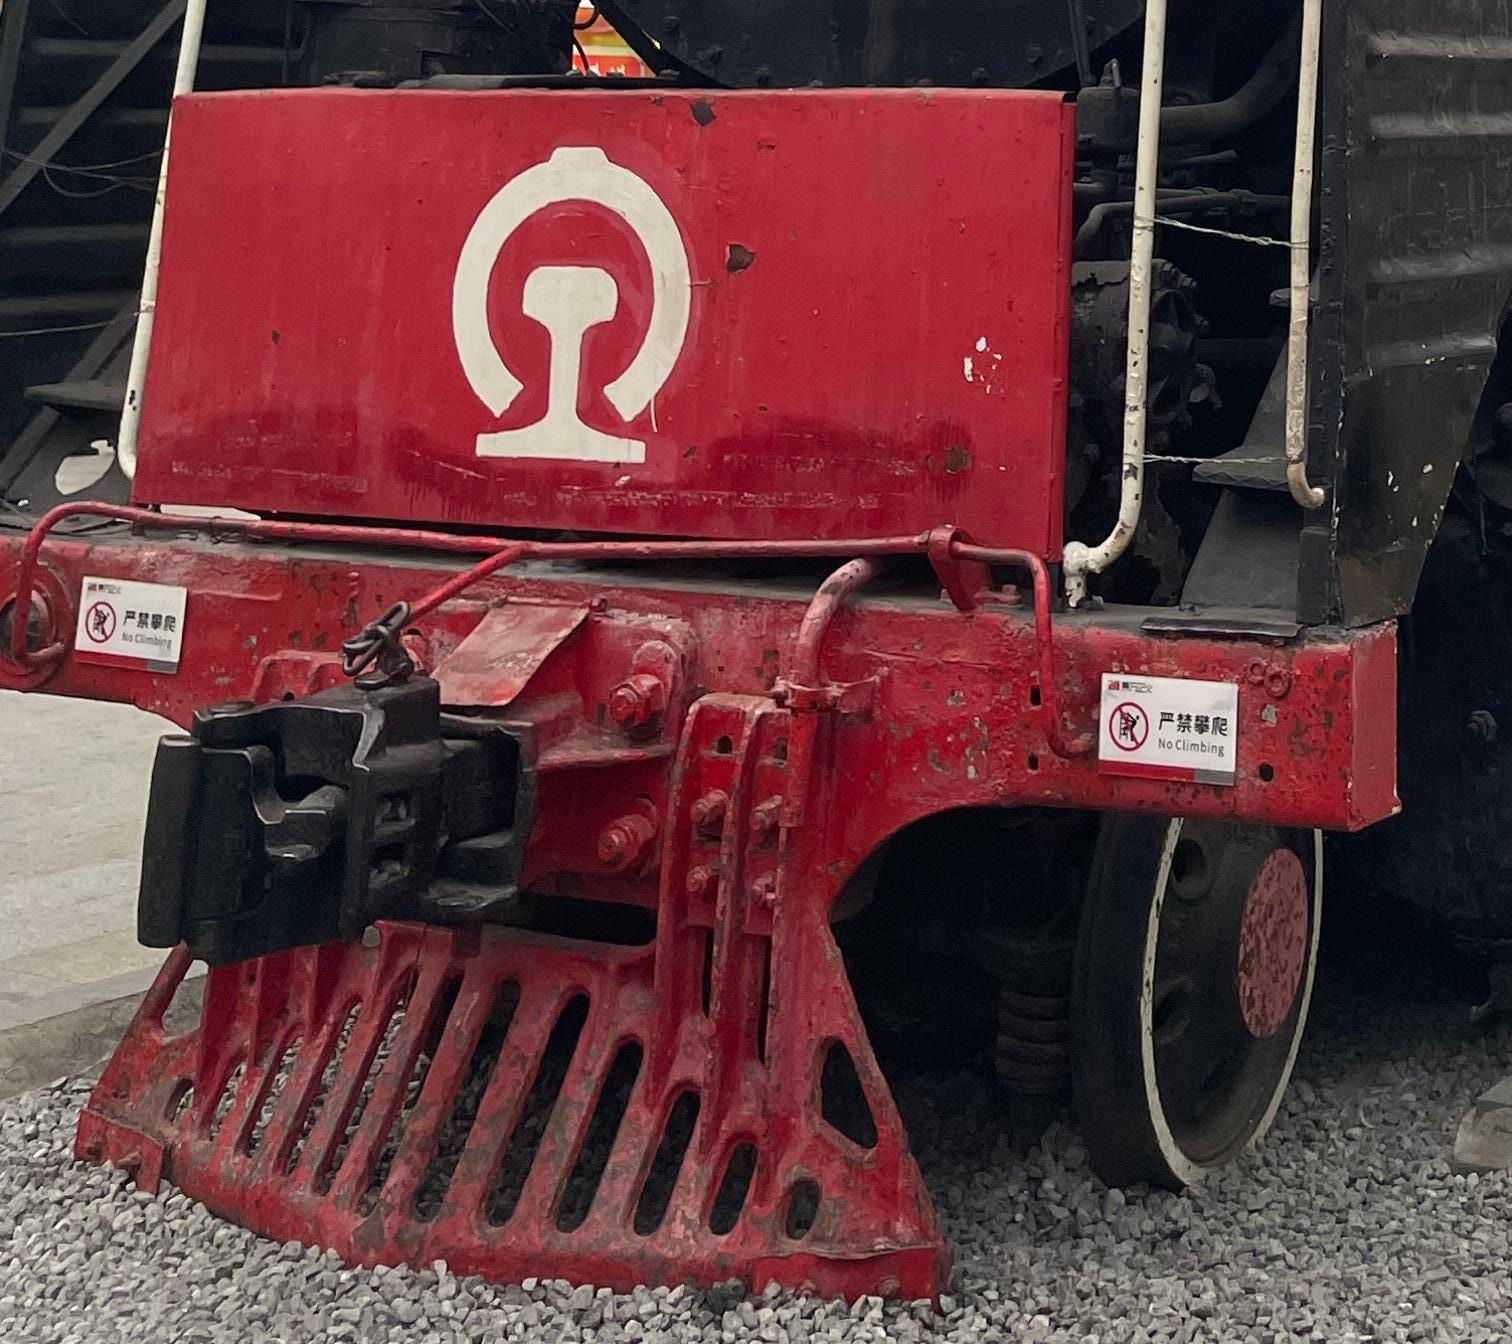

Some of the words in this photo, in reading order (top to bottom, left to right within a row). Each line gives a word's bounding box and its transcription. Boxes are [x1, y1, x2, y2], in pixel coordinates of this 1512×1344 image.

[122, 610, 177, 633] 严禁攀爬
[121, 631, 134, 642] No
[134, 632, 173, 651] Climbing
[1158, 711, 1229, 737] 严禁攀爬
[1158, 737, 1173, 749] No
[1175, 738, 1225, 758] Climbing
